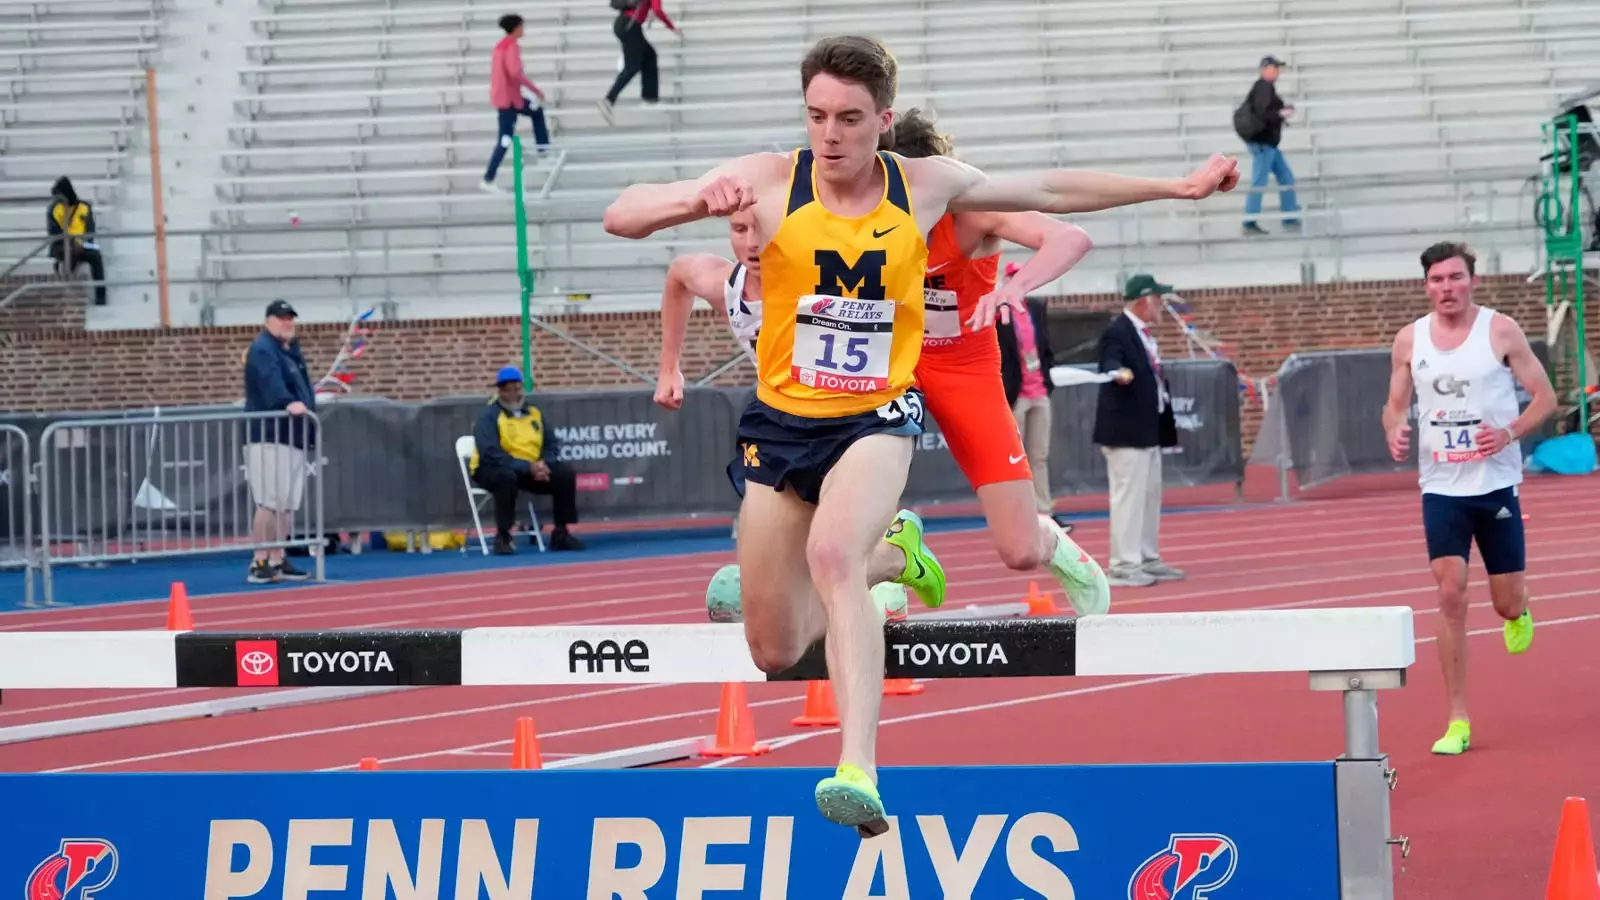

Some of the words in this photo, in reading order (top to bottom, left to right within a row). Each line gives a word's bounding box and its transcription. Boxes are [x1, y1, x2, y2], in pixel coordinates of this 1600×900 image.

[815, 249, 886, 300] M
[837, 309, 884, 320] RELAYS
[840, 301, 876, 311] PENN
[811, 317, 837, 329] Dream
[837, 322, 852, 331] On.
[815, 333, 869, 373] 15
[819, 375, 877, 392] TOYOTA
[554, 425, 600, 442] MAKE
[604, 423, 657, 440] EVERY
[1443, 429, 1472, 449] 14
[557, 444, 609, 461] COND
[612, 441, 671, 458] COUNT.
[741, 443, 761, 467] M
[288, 650, 394, 673] TOYOTA
[893, 642, 1009, 666] TOYOTA
[202, 817, 540, 900] PENN
[586, 812, 1080, 900] RELAYS
